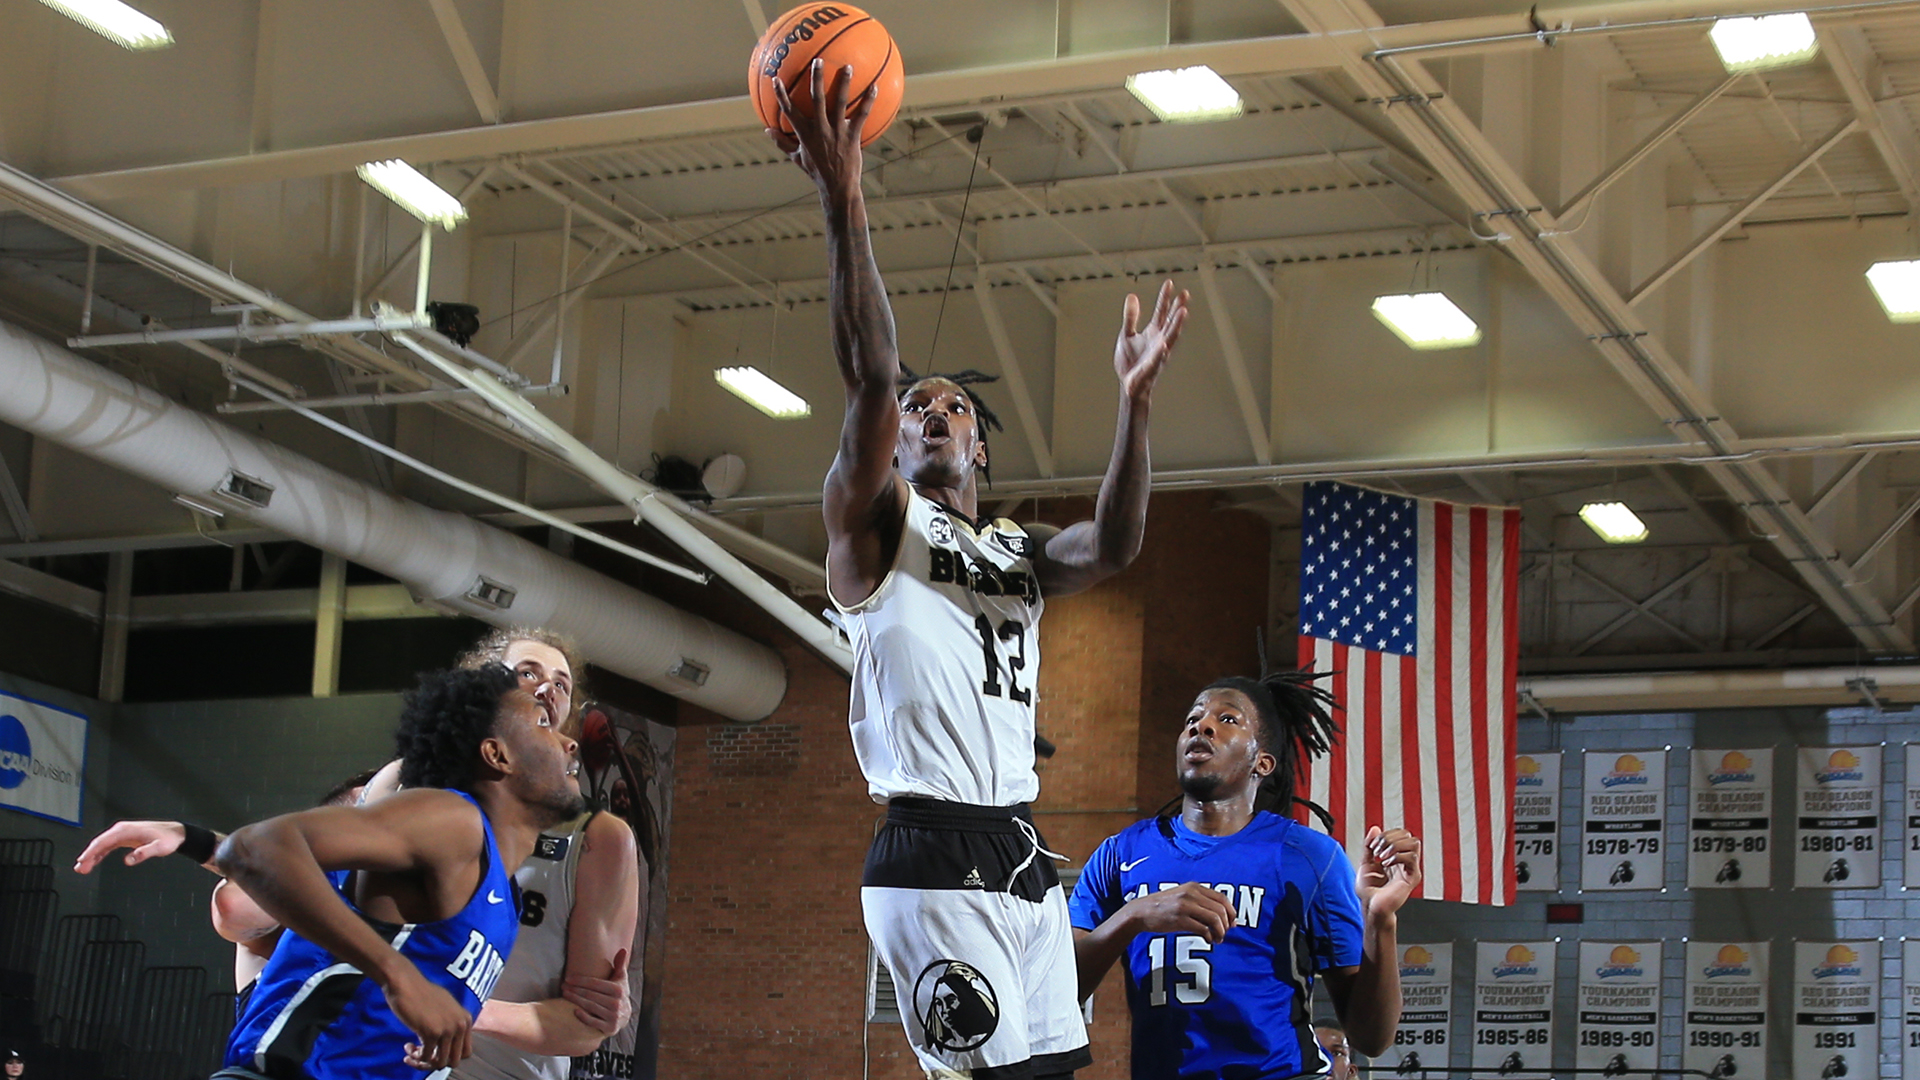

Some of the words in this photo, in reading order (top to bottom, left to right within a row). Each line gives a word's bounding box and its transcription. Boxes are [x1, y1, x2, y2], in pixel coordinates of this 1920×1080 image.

[975, 612, 1031, 708] 12
[0, 749, 31, 777] CAA
[33, 758, 72, 785] Division
[1614, 794, 1658, 805] SEASON
[1828, 790, 1874, 800] SEASON
[1592, 805, 1656, 816] CHAMPIONS
[1698, 803, 1764, 813] CHAMPIONS
[1804, 801, 1872, 812] CHAMPIONS
[1515, 838, 1553, 856] 7-78
[1587, 838, 1659, 855] 1978-79
[1693, 836, 1767, 852] 1979-80
[1801, 835, 1874, 852] 1980-81
[1148, 935, 1213, 1006] 15
[1478, 985, 1552, 996] TOURNAMENT
[1581, 985, 1657, 997] TOURNAMENT
[1403, 996, 1443, 1006] MPIONS
[1482, 996, 1545, 1007] CHAMPIONS
[1586, 996, 1651, 1007] CHAMPIONS
[1693, 996, 1759, 1007] CHAMPIONS
[1802, 997, 1870, 1007] CHAMPIONS
[1395, 1029, 1446, 1046] 85-86
[1477, 1029, 1549, 1046] 1985-86
[1581, 1030, 1654, 1047] 1989-90
[1690, 1030, 1761, 1048] 1990-91
[1814, 1032, 1856, 1048] 1991
